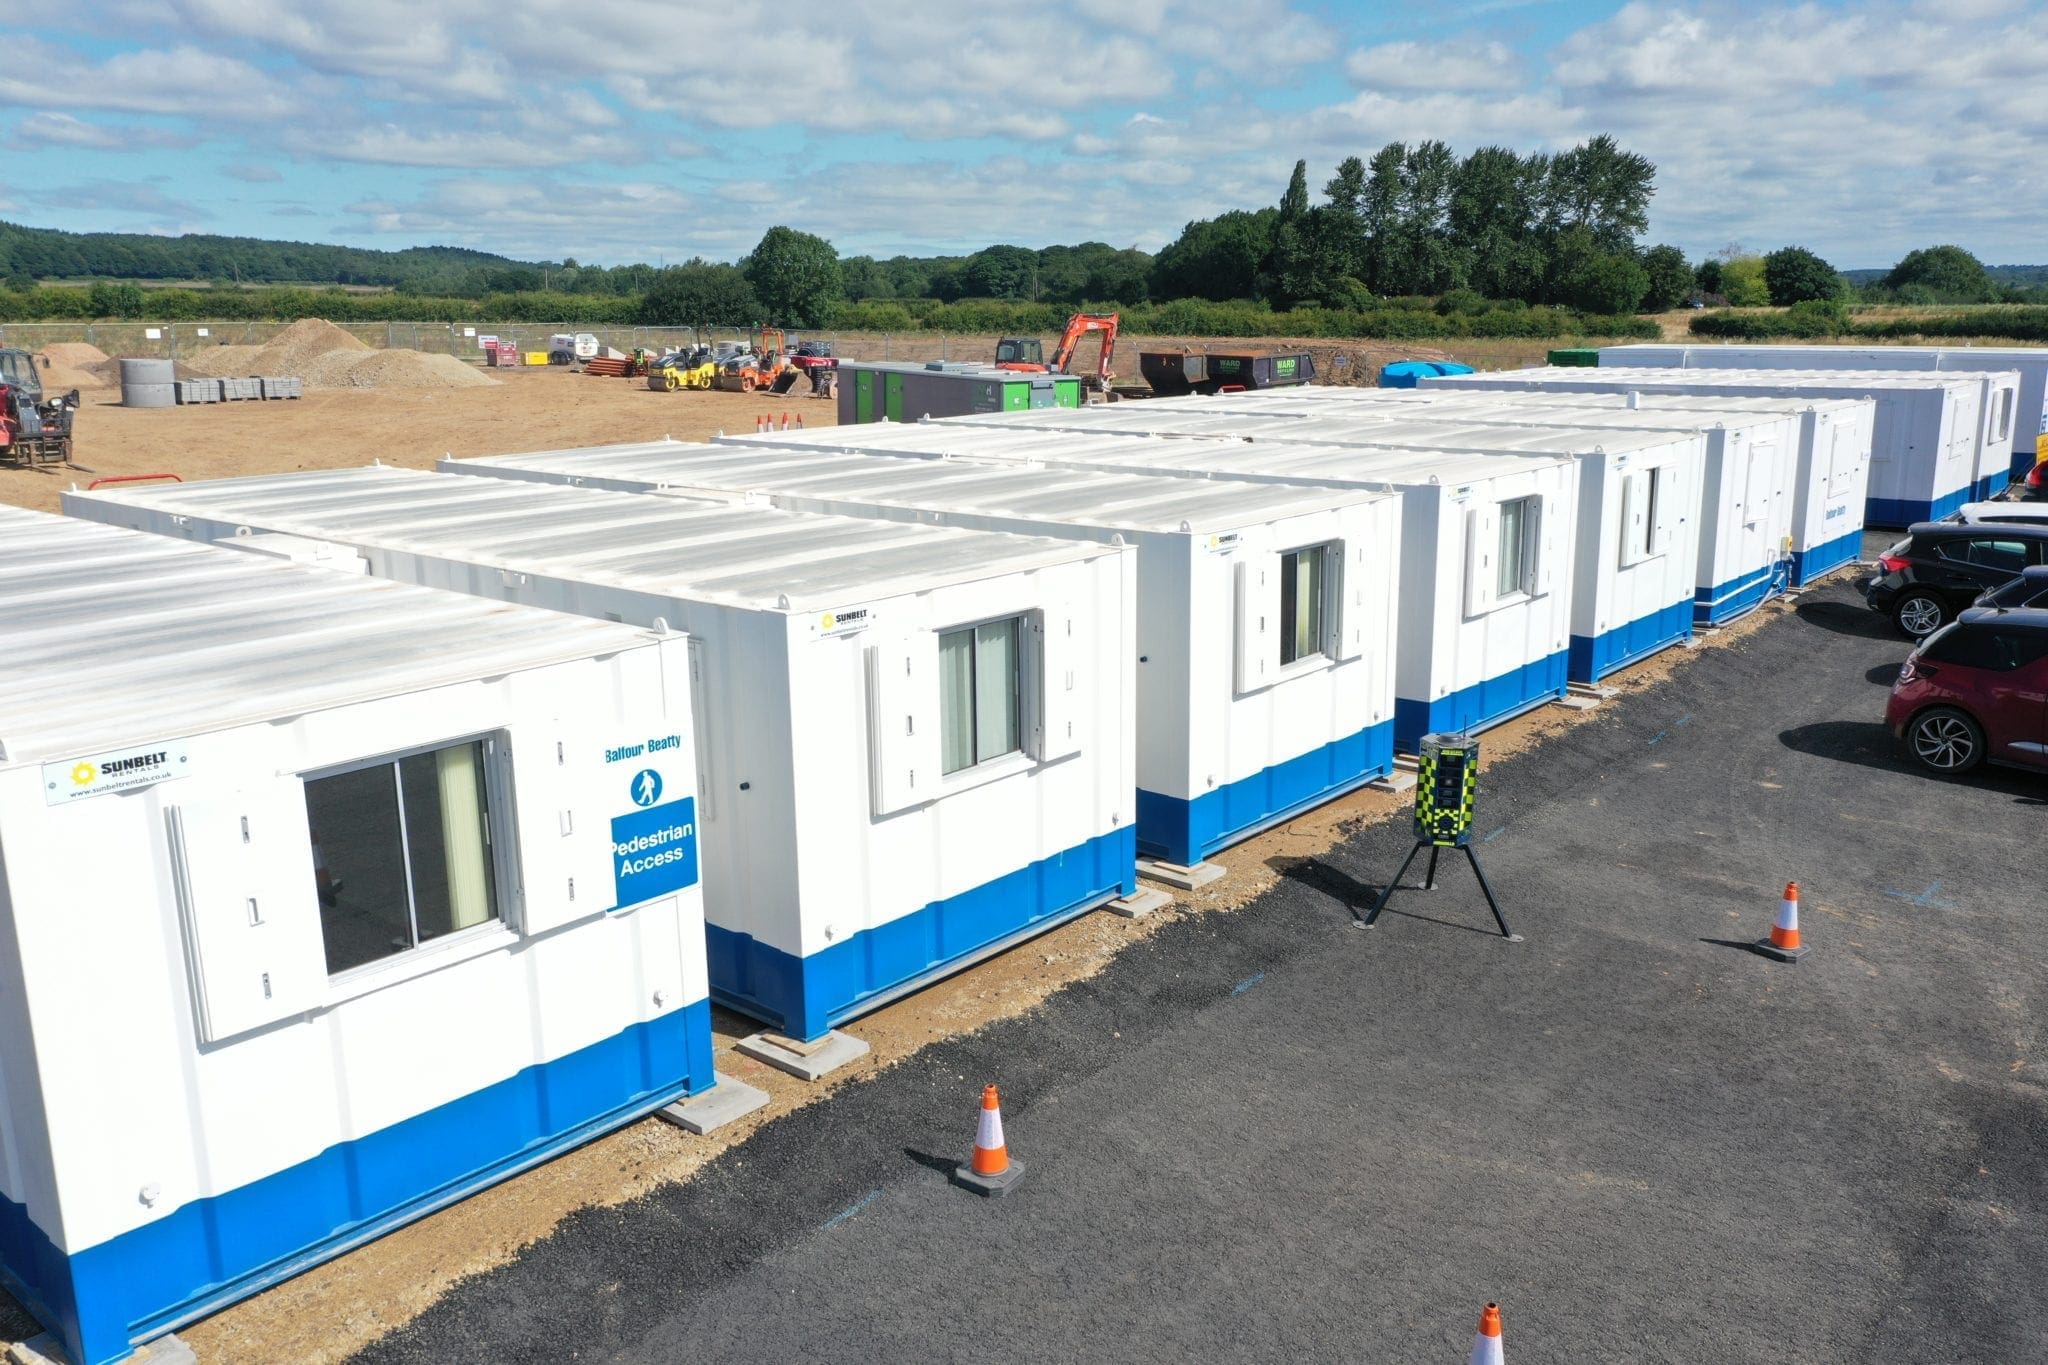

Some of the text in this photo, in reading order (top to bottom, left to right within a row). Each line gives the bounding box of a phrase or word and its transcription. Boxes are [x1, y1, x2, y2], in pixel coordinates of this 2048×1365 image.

[1276, 359, 1295, 369] WARD
[836, 609, 867, 623] SUNBELT
[605, 734, 681, 763] Balfour Beatty
[101, 751, 168, 775] SUNBELT
[111, 765, 159, 778] RENTALS
[69, 771, 172, 798] www.sunbeltrentals.co.uk
[610, 823, 693, 857] Pedestrian
[621, 847, 684, 877] Access
